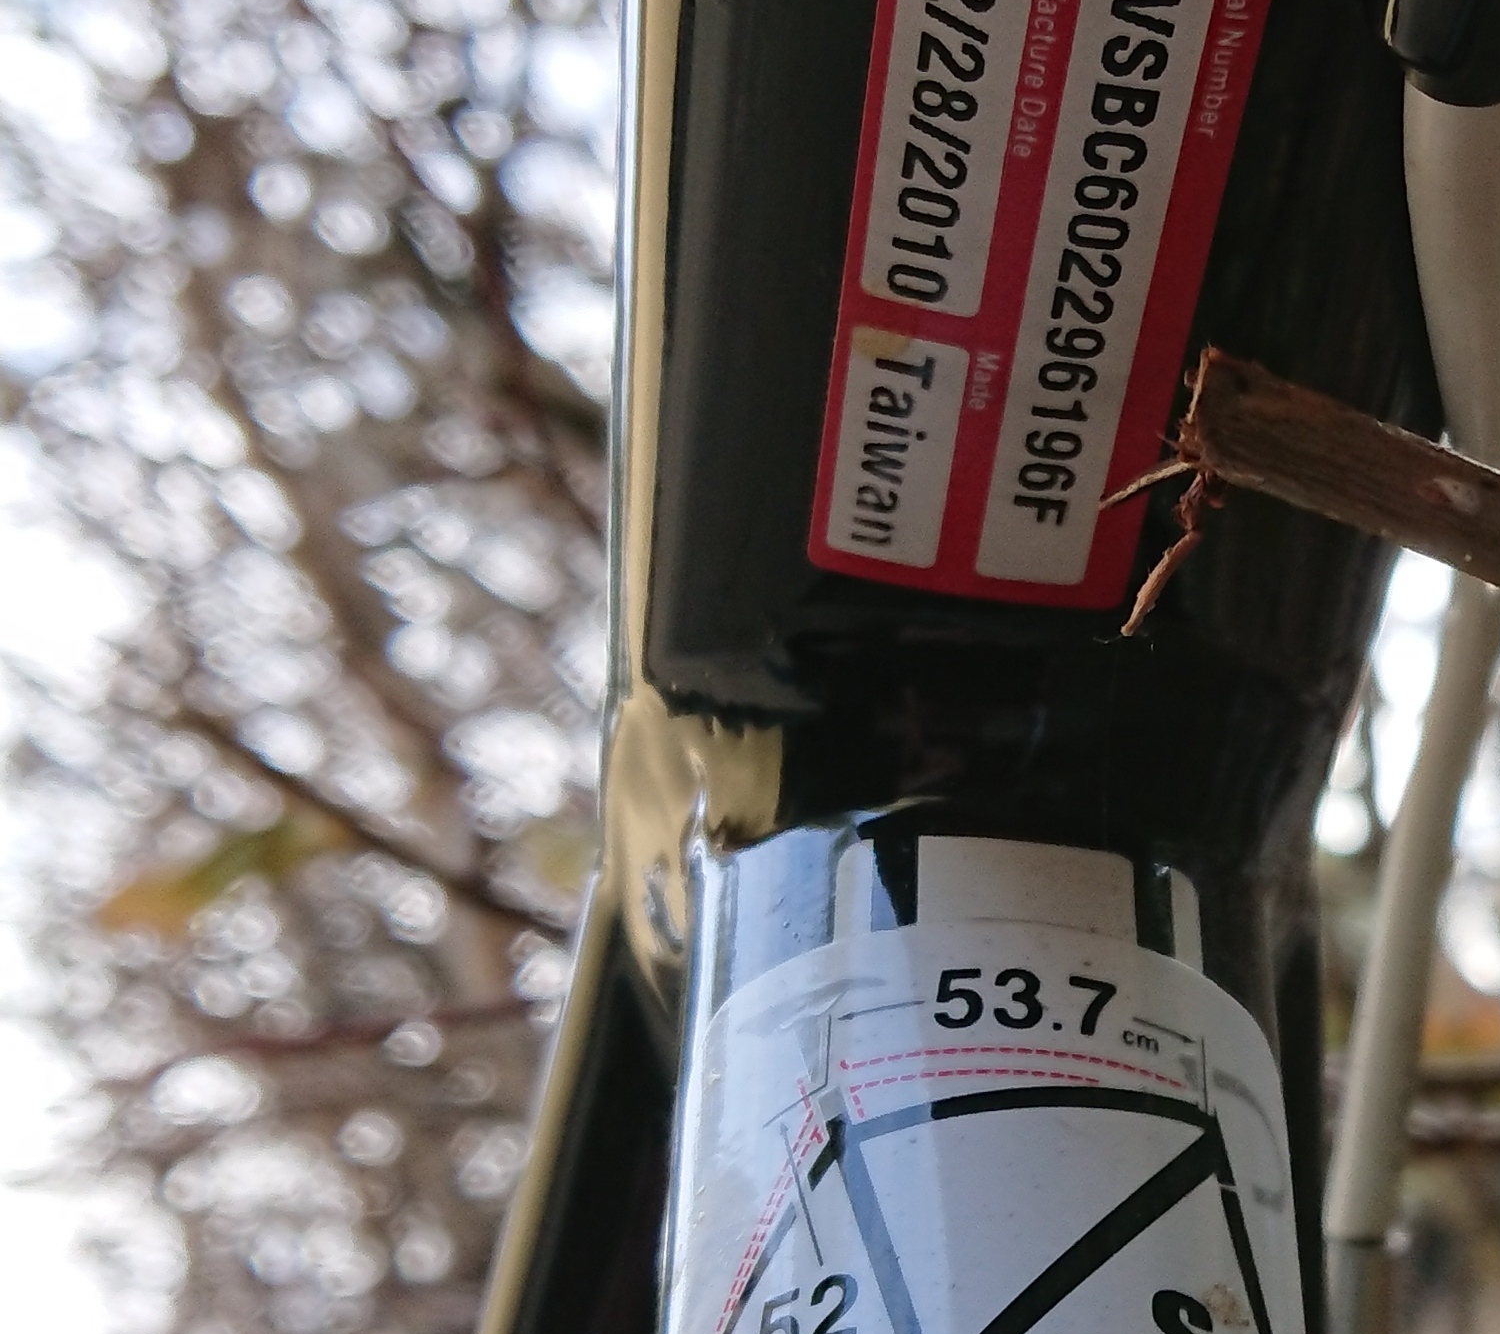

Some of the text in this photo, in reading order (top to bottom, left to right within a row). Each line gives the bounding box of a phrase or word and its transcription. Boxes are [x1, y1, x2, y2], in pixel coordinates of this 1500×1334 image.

[1012, 95, 1048, 159] Date
[1200, 29, 1244, 138] Number
[967, 351, 1000, 412] Made
[850, 356, 936, 548] Taiwan
[932, 967, 1161, 1054] 53.7 cm
